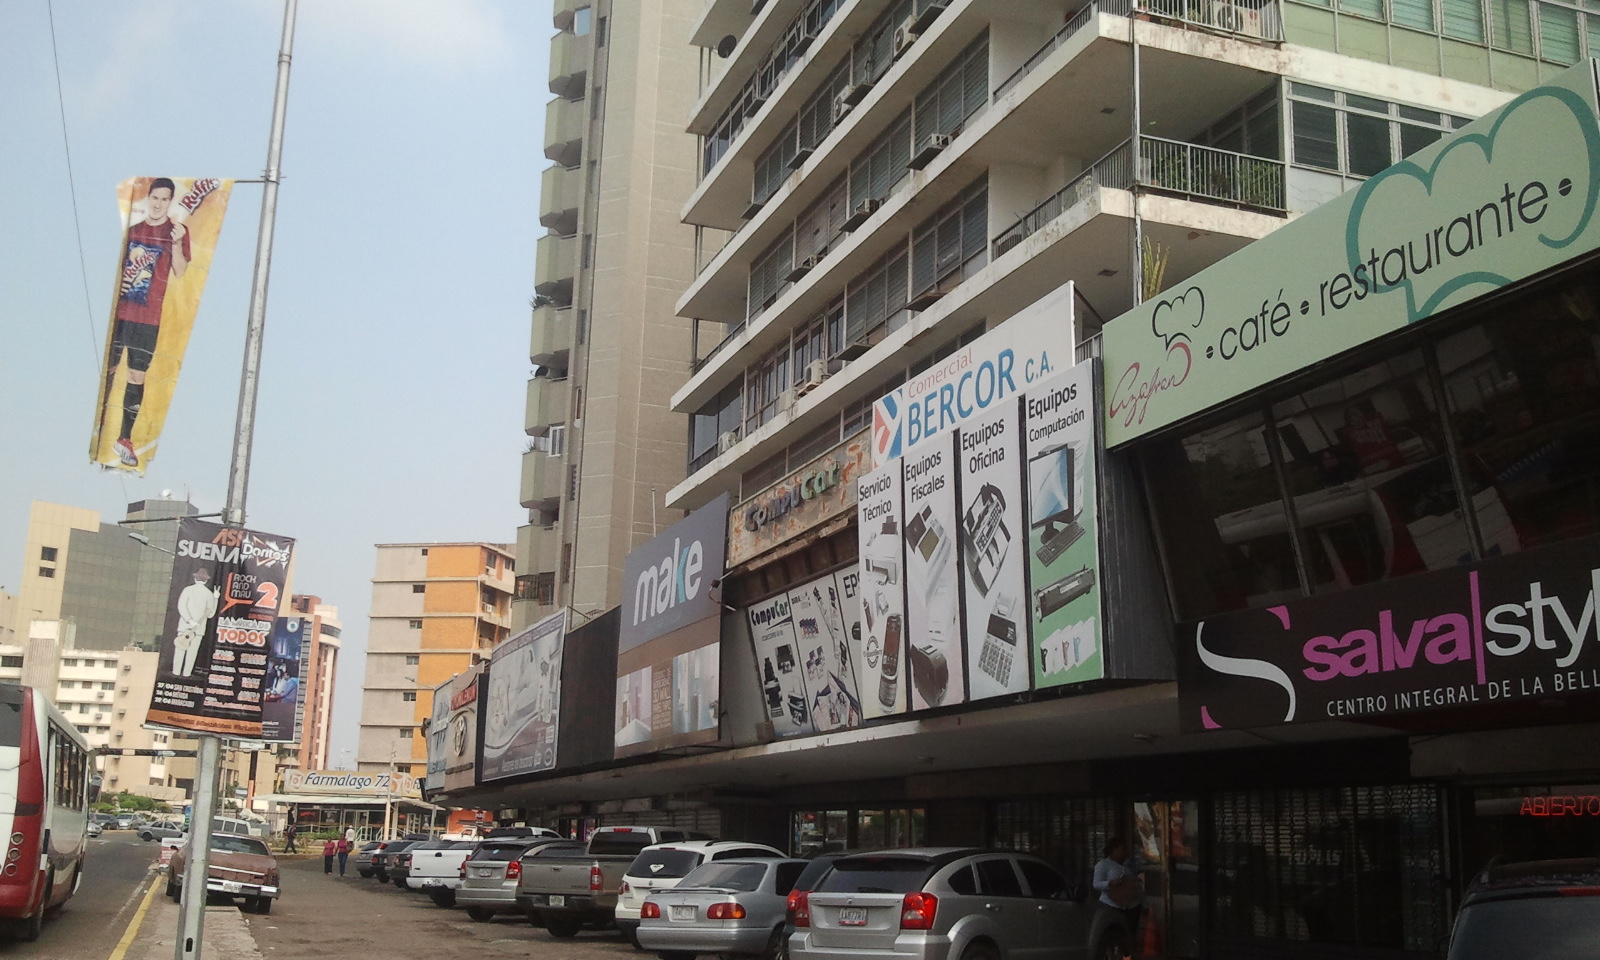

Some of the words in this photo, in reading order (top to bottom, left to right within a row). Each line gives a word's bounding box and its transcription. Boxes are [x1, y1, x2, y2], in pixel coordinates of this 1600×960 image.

[1219, 288, 1291, 361] café
[1319, 181, 1548, 317] restaurante
[908, 347, 973, 399] Comercial
[907, 348, 1017, 448] BERCOR
[1025, 351, 1054, 384] C.A.
[1028, 383, 1078, 420] Equipos
[962, 418, 1005, 452] Equipos
[1029, 408, 1085, 443] Computación
[905, 451, 942, 482] Equipos
[969, 446, 1005, 475] Oficina
[859, 474, 892, 502] Servicio
[911, 473, 945, 504] Fiscales
[862, 499, 892, 523] Técnico
[177, 539, 241, 564] SUENA
[243, 544, 289, 562] Doritos
[232, 581, 250, 590] AND
[255, 581, 279, 609] 2
[633, 537, 703, 626] make
[217, 627, 268, 646] TODOS
[1326, 695, 1388, 717] CENTRO
[1394, 684, 1479, 711] INTEGRAL
[1488, 679, 1512, 700] DE
[1520, 675, 1544, 696] LA
[304, 772, 372, 790] Farmalago
[374, 775, 390, 788] 72
[1519, 795, 1600, 816] ABIERTO
